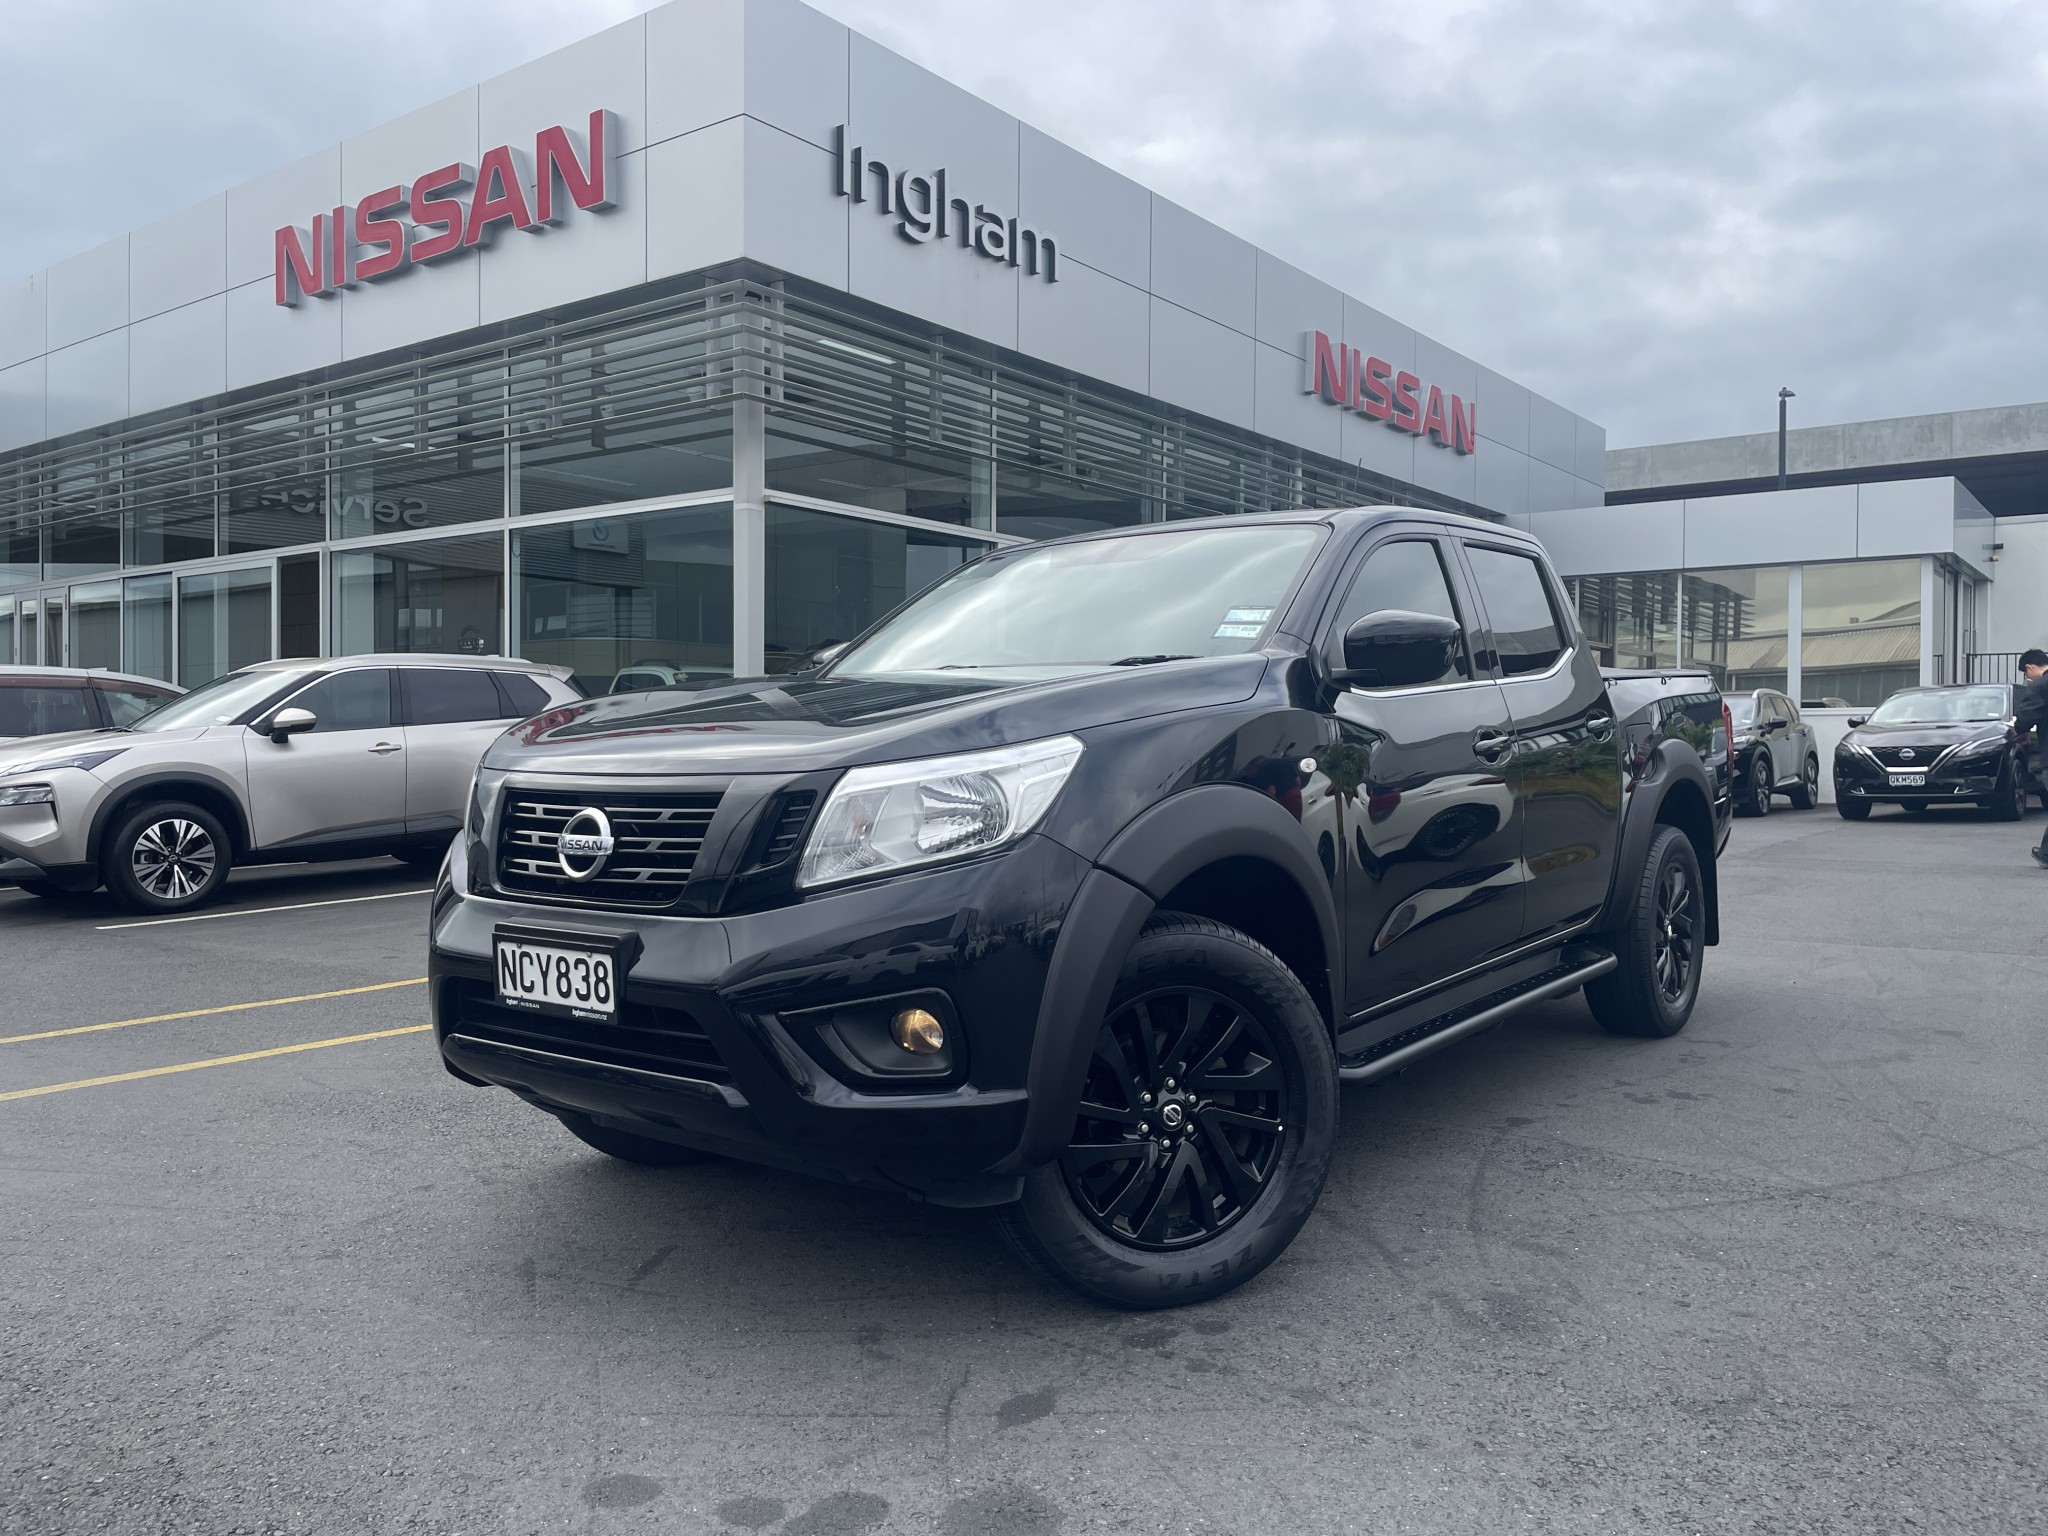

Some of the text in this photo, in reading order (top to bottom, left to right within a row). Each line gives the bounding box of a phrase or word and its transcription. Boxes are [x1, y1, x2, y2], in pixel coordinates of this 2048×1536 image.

[275, 108, 615, 308] NISSAN
[835, 123, 1060, 283] Ingham
[1304, 329, 1477, 456] NISSAN
[1890, 776, 1924, 784] QKM569
[560, 838, 603, 851] NISSAN
[500, 948, 610, 1004] NCY838
[1158, 1242, 1257, 1291] ZETA
